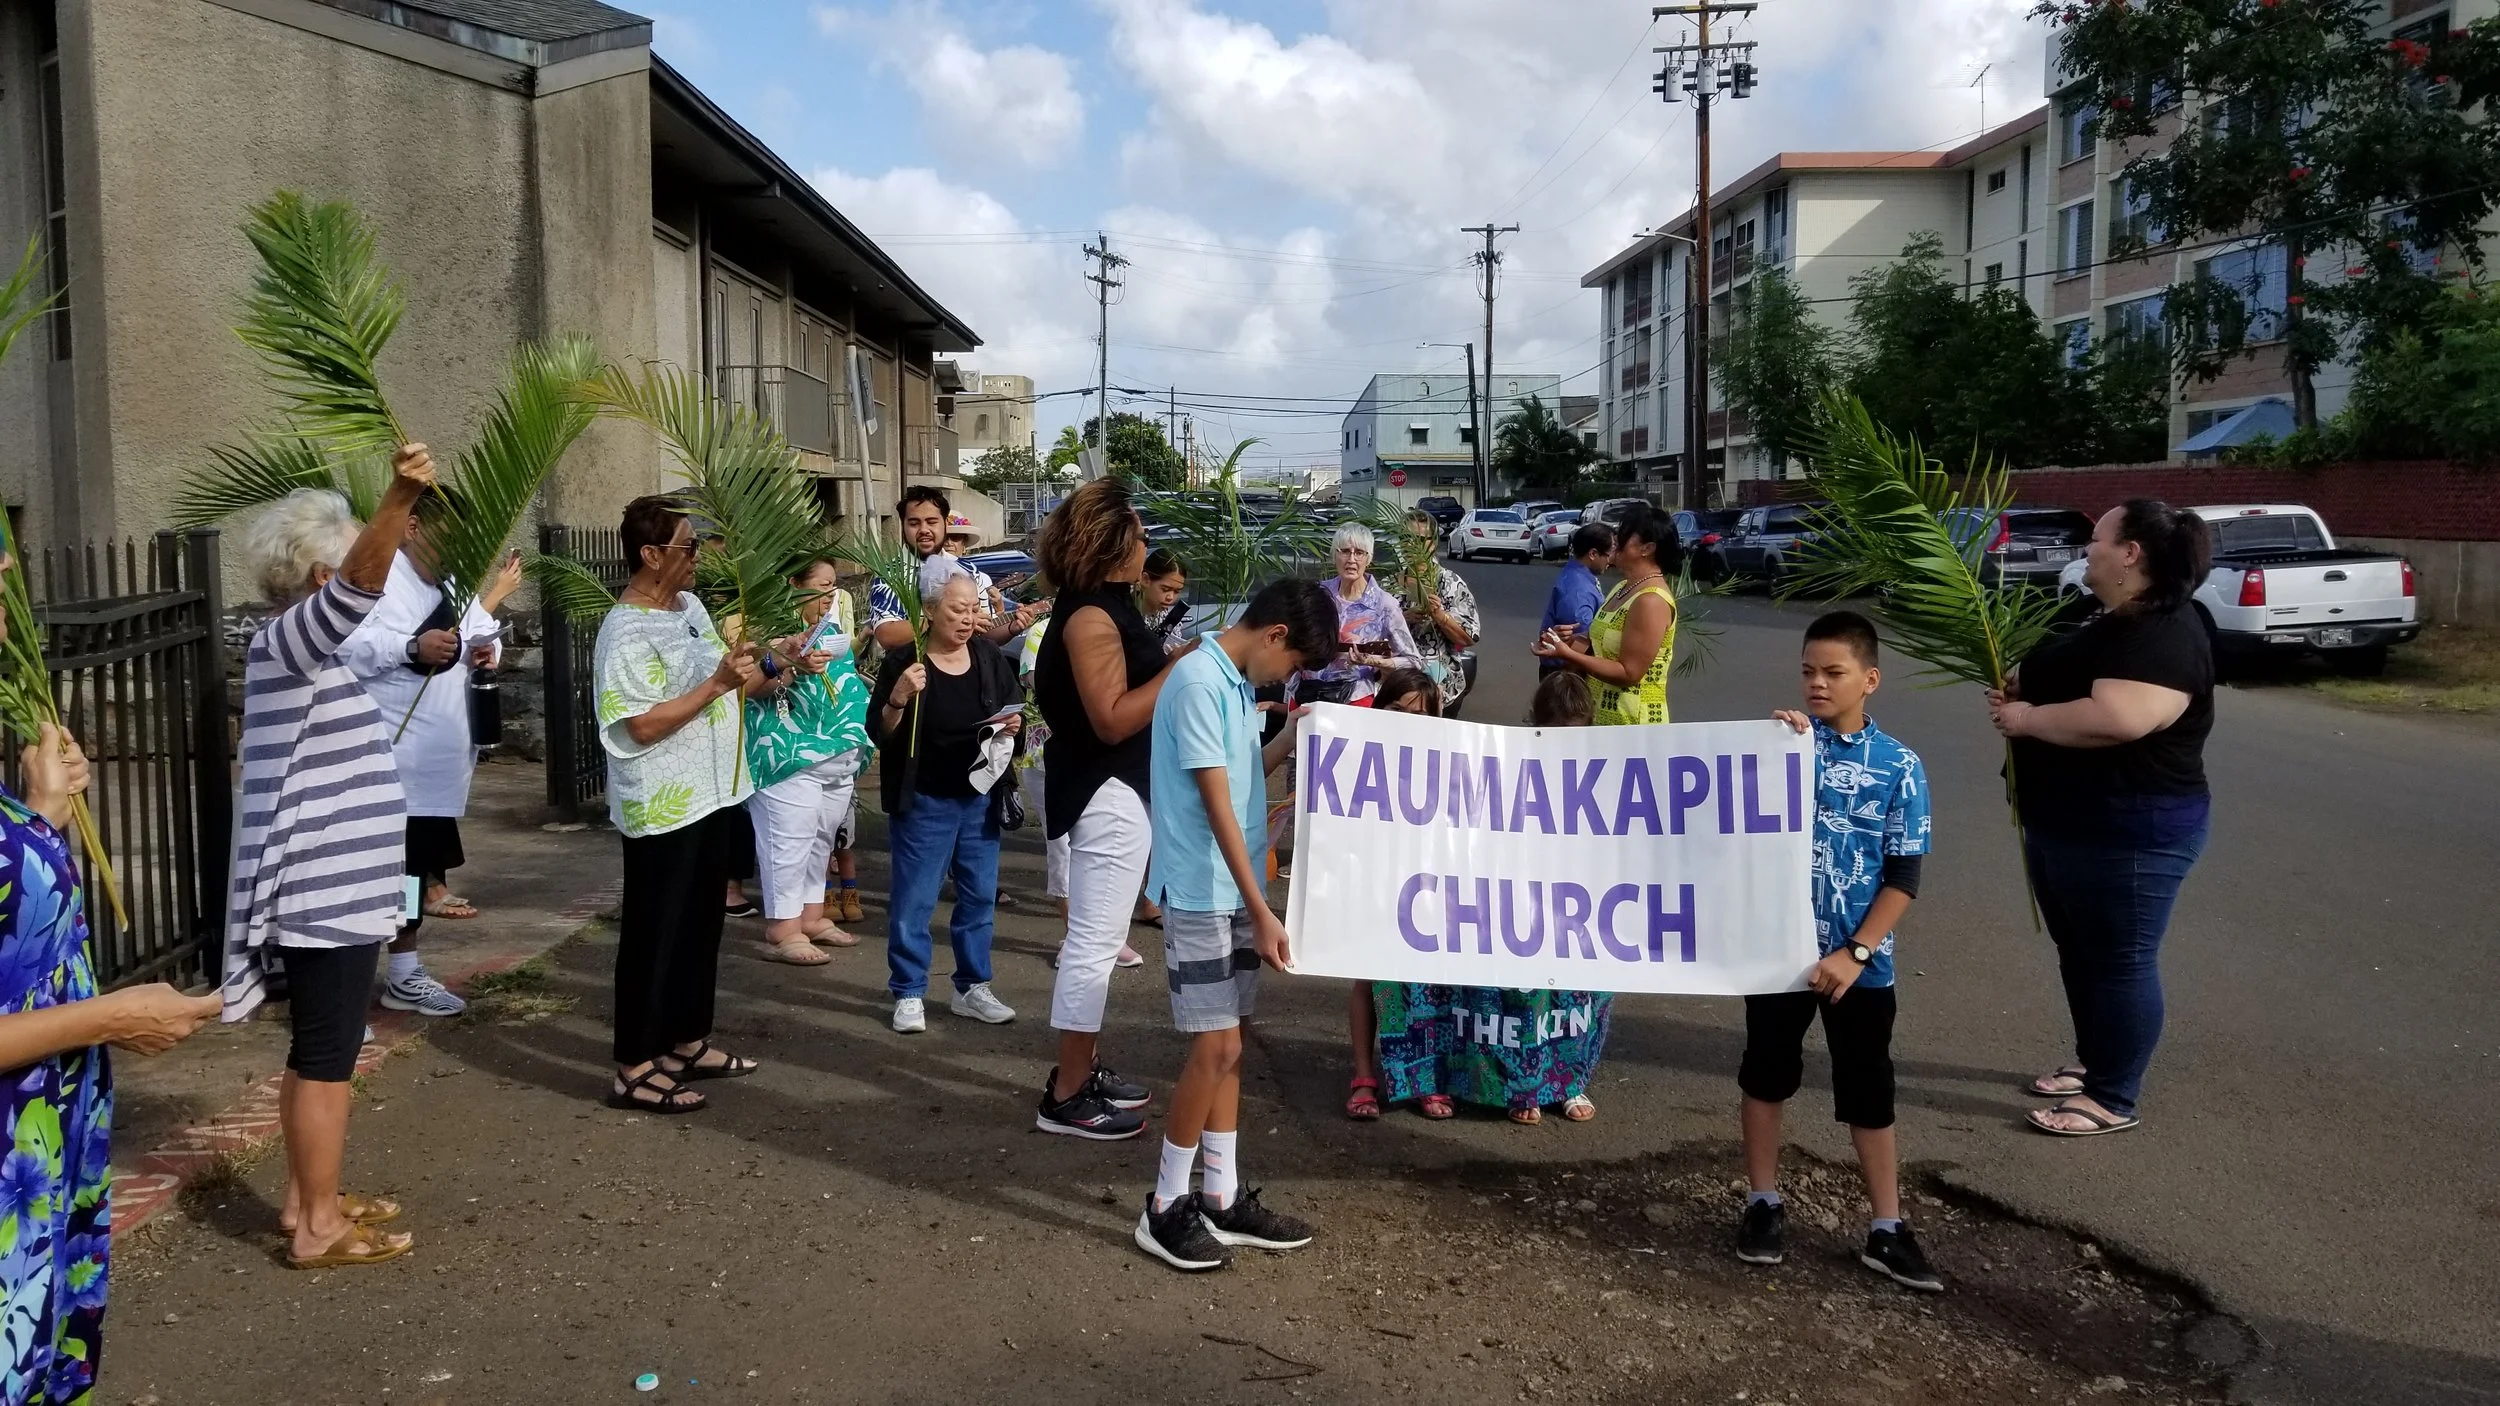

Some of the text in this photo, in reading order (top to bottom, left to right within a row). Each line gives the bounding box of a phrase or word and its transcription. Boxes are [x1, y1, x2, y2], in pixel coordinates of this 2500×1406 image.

[1390, 475, 1406, 483] STOP
[1306, 733, 1804, 836] KAUMAKAPILI
[1396, 872, 1697, 964] CHURCH
[1452, 1007, 1522, 1048] THE
